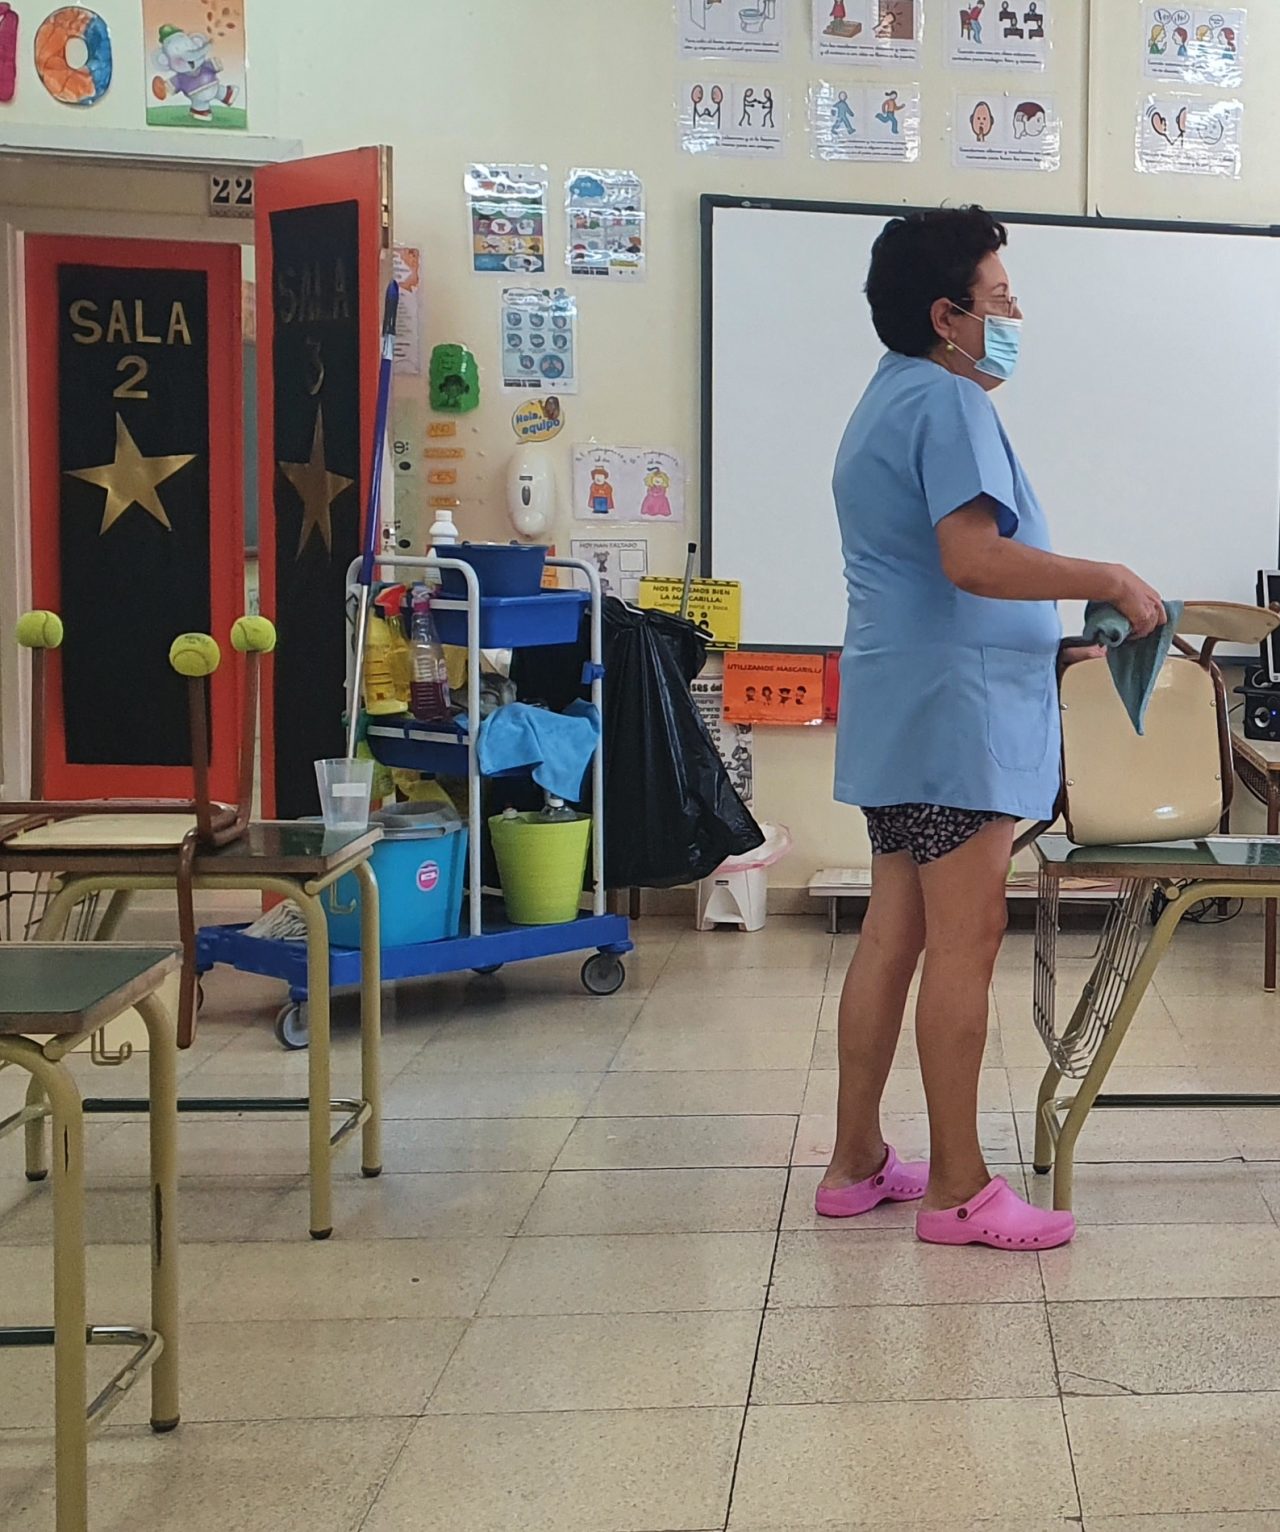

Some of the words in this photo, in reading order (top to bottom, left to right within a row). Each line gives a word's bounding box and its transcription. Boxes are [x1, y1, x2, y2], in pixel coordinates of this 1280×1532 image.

[211, 175, 254, 205] 22
[69, 299, 193, 345] SALA
[112, 354, 149, 399] 2
[522, 418, 560, 436] equipo
[711, 588, 731, 596] BIEN
[727, 663, 774, 672] UTILIZAMOS
